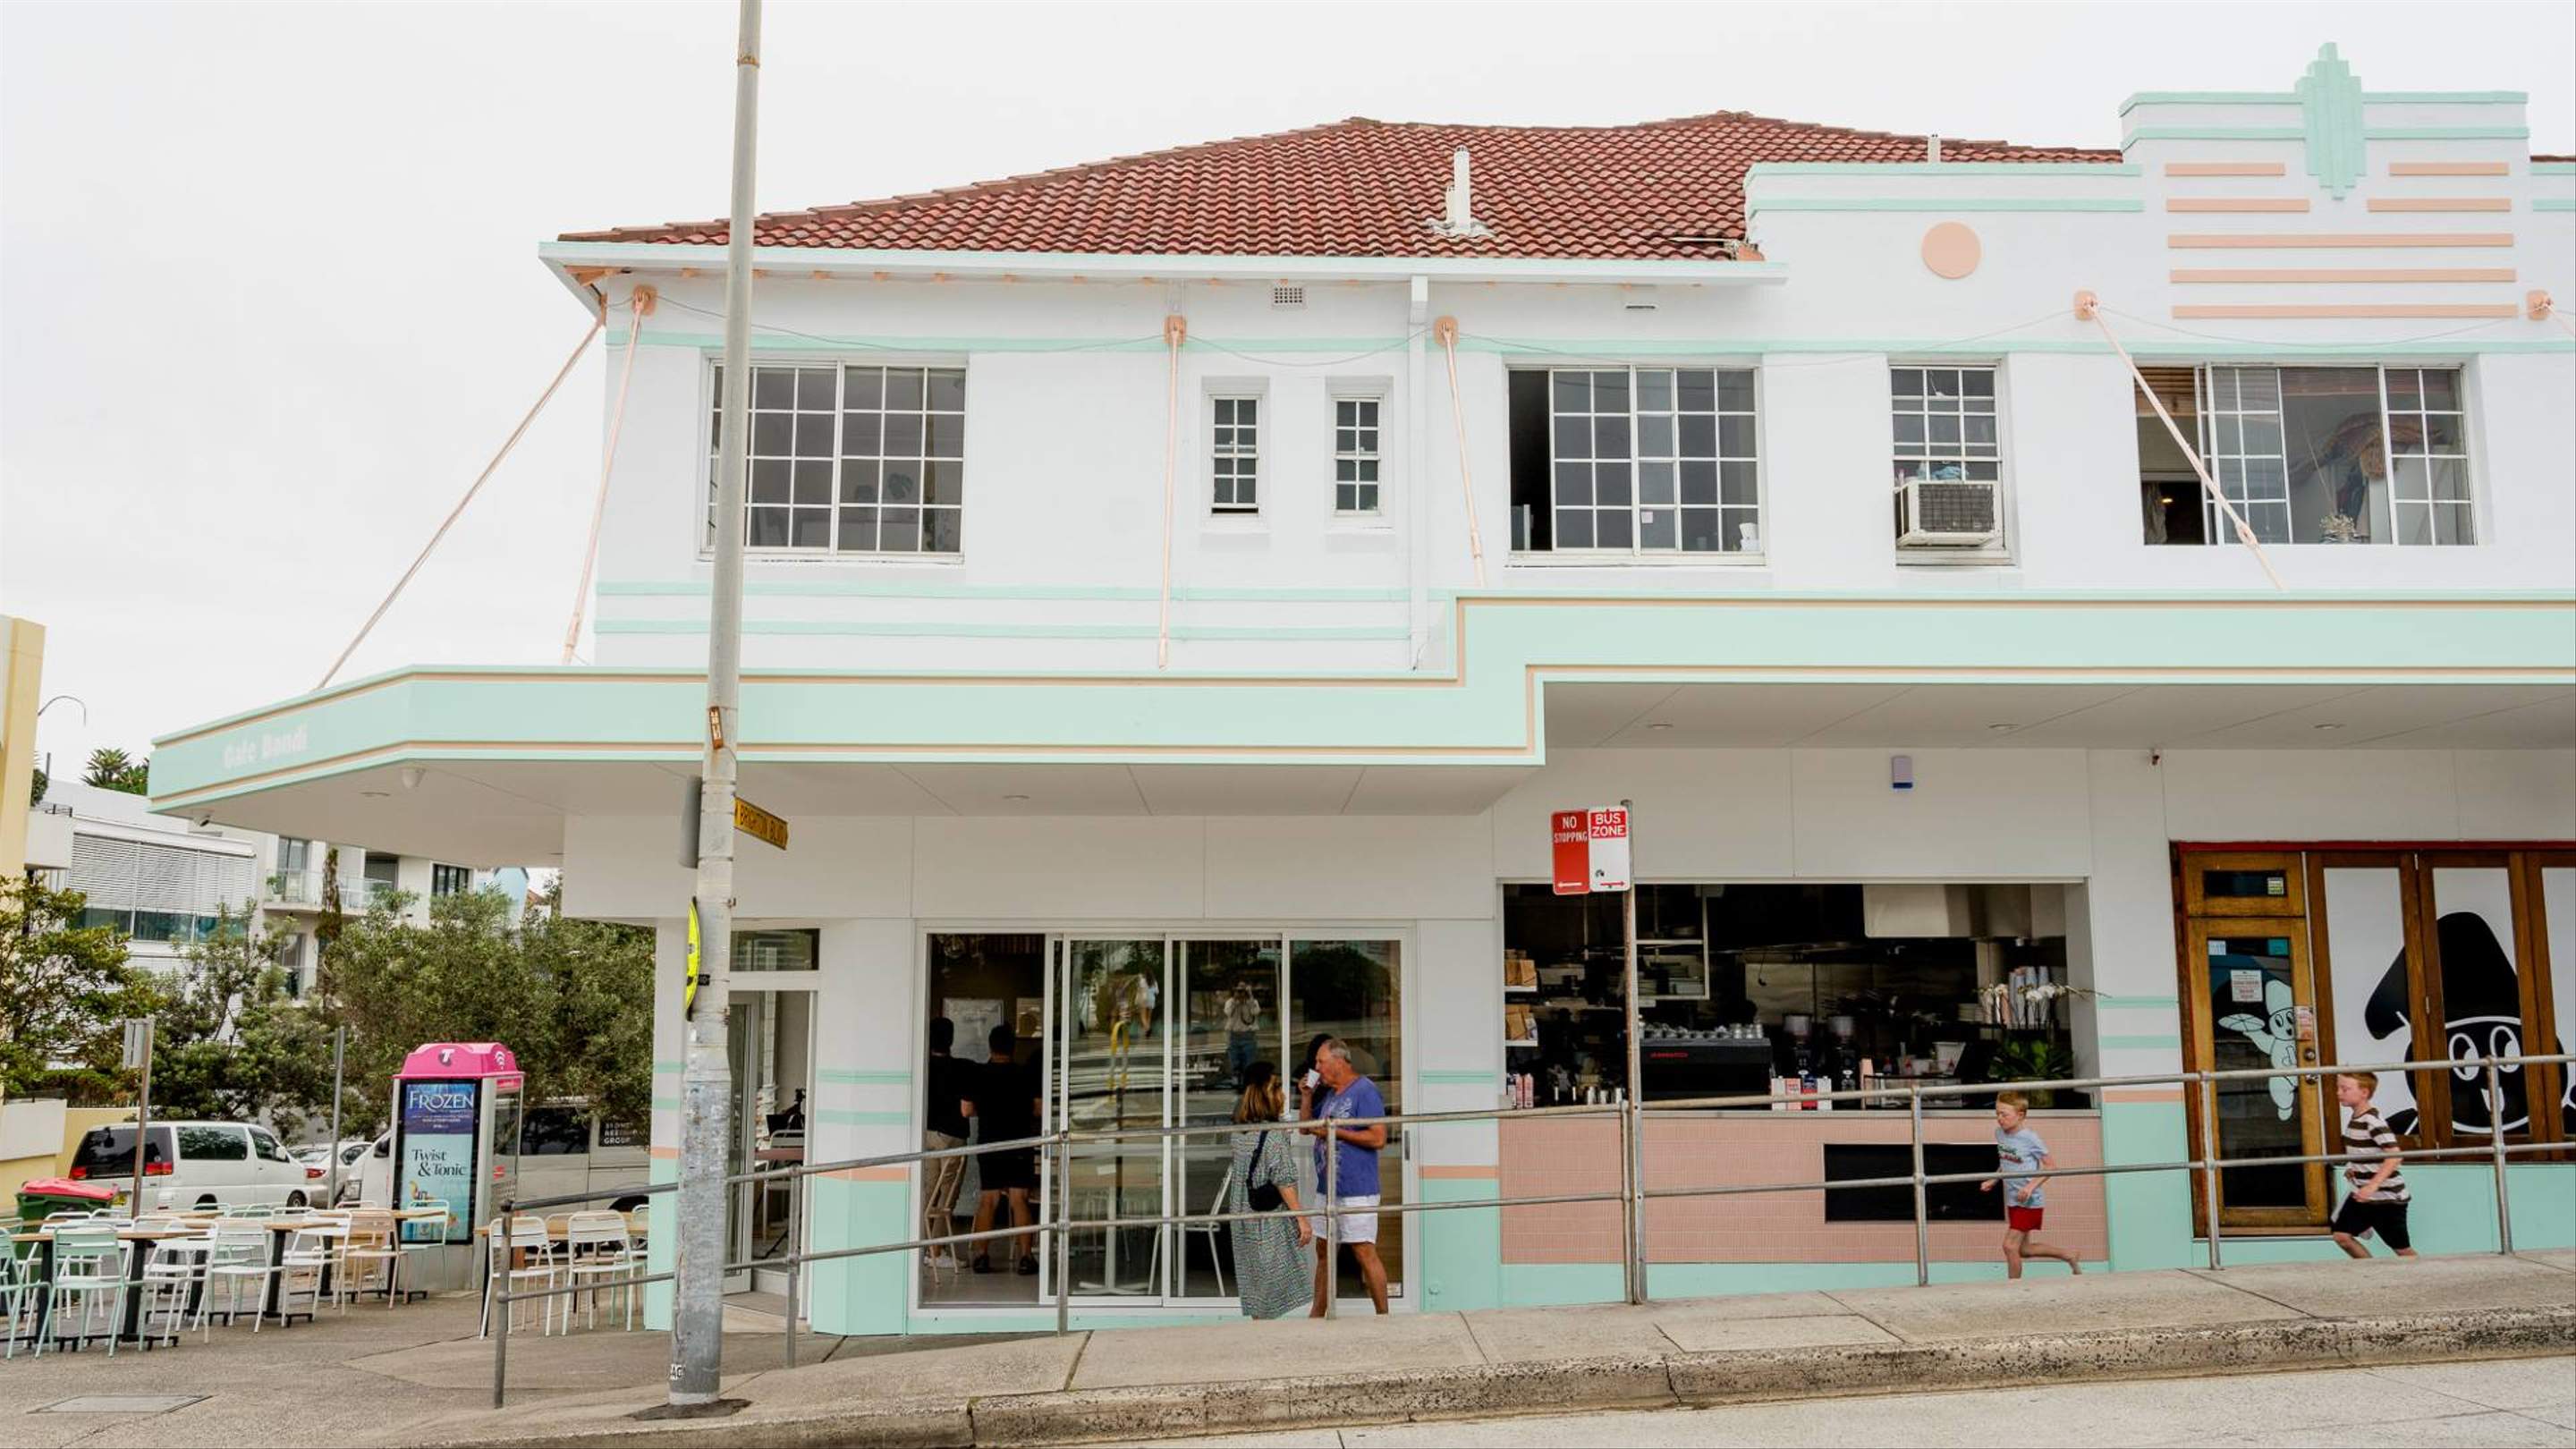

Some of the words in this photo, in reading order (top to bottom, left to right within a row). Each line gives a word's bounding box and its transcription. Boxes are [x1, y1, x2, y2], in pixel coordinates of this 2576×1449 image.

[1562, 815, 1577, 829] NO
[1595, 812, 1621, 825] BUS
[1554, 831, 1589, 843] STOPPING
[1592, 825, 1625, 837] ZONE
[409, 1090, 475, 1113] FROZEN
[411, 1148, 446, 1161] Twist
[418, 1162, 431, 1177] &
[433, 1163, 468, 1176] Tonic
